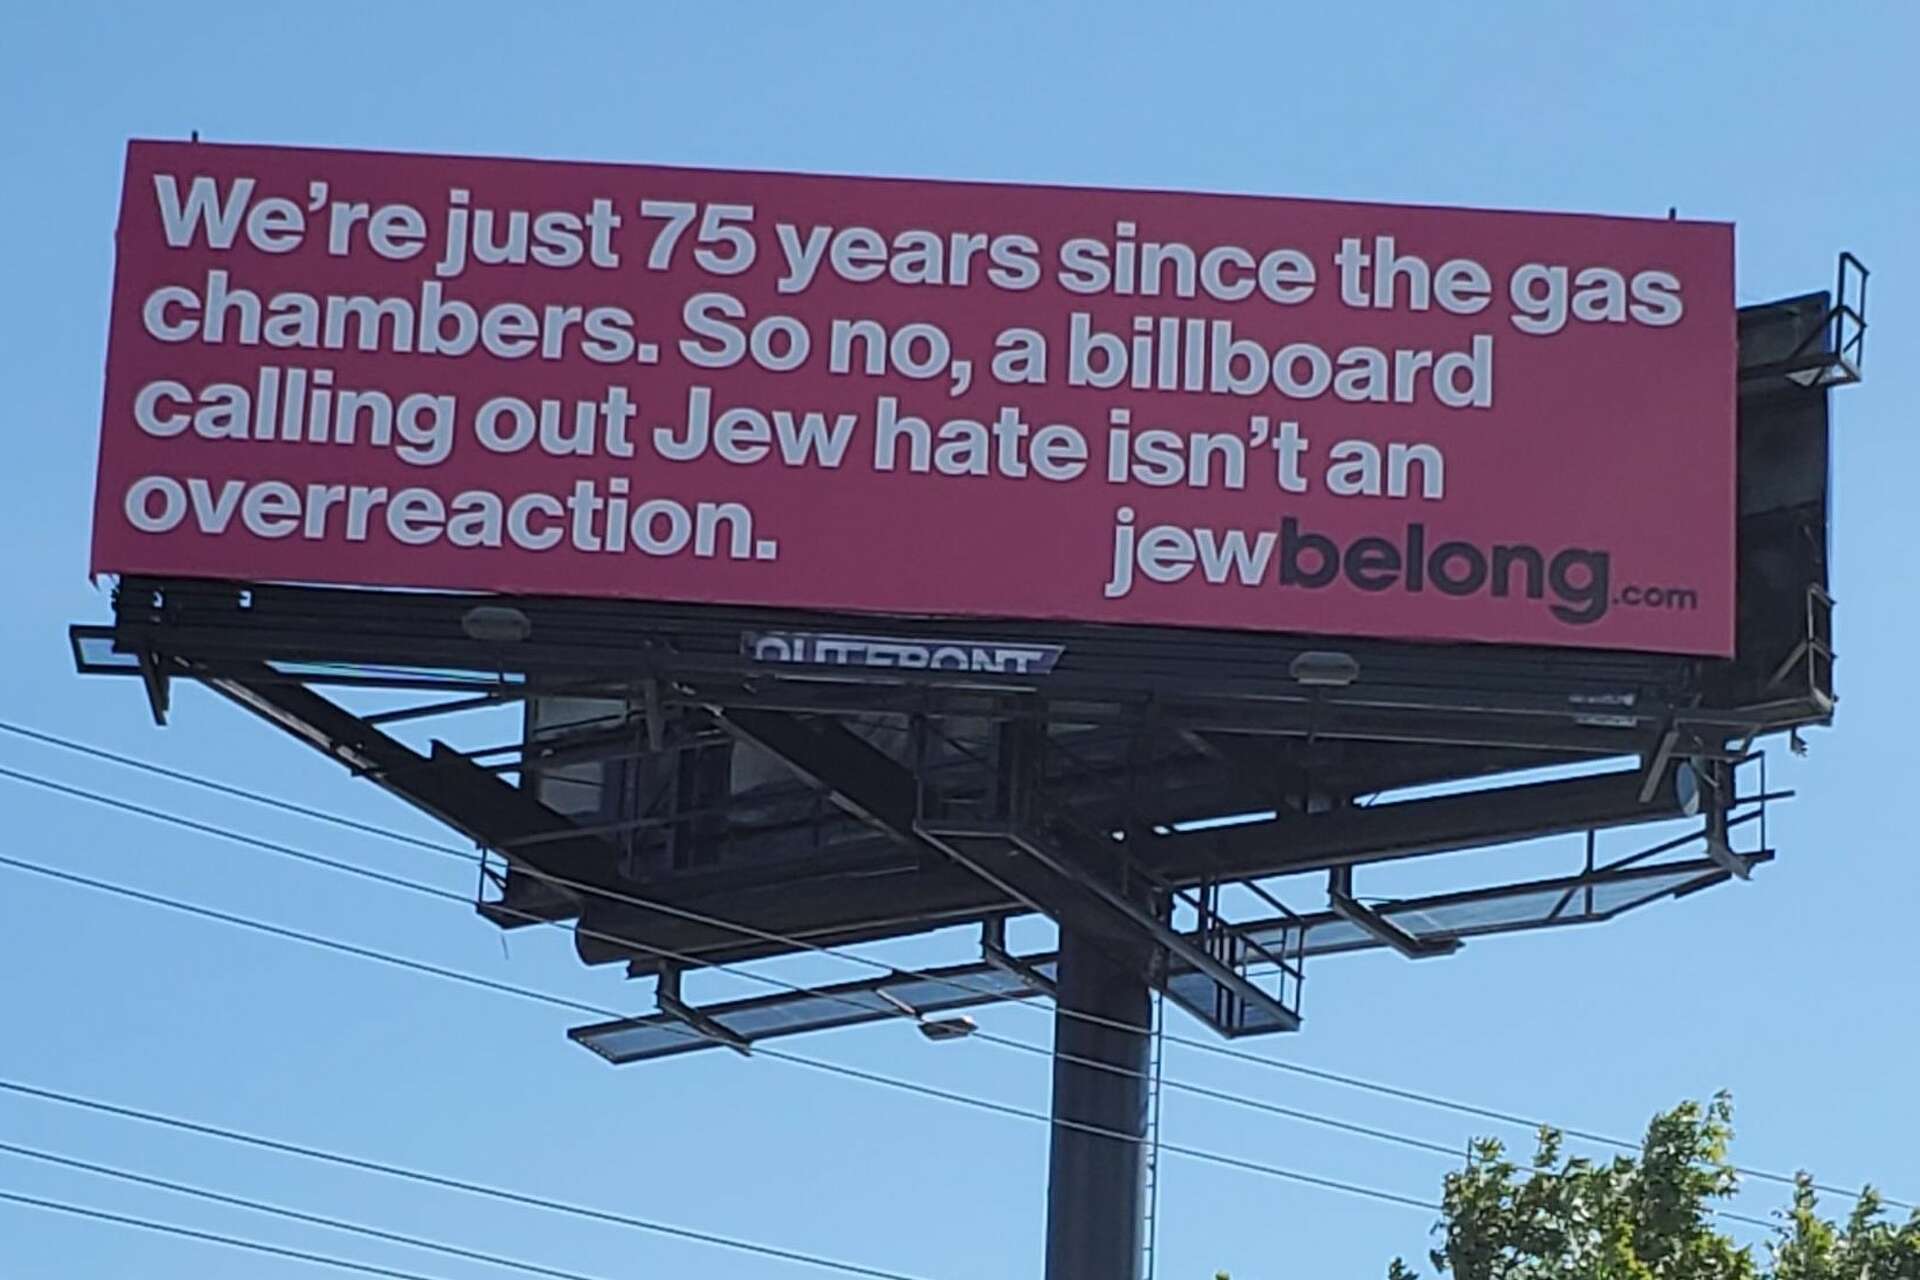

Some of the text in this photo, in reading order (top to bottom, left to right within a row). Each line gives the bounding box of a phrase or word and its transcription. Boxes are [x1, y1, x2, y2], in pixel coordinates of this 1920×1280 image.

[153, 174, 1684, 335] We’re just 75 years since the gas
[142, 269, 1494, 408] chambers. So no, a billboard
[133, 365, 1445, 499] calling out Jew hate isn’t an
[124, 475, 778, 561] overreaction.
